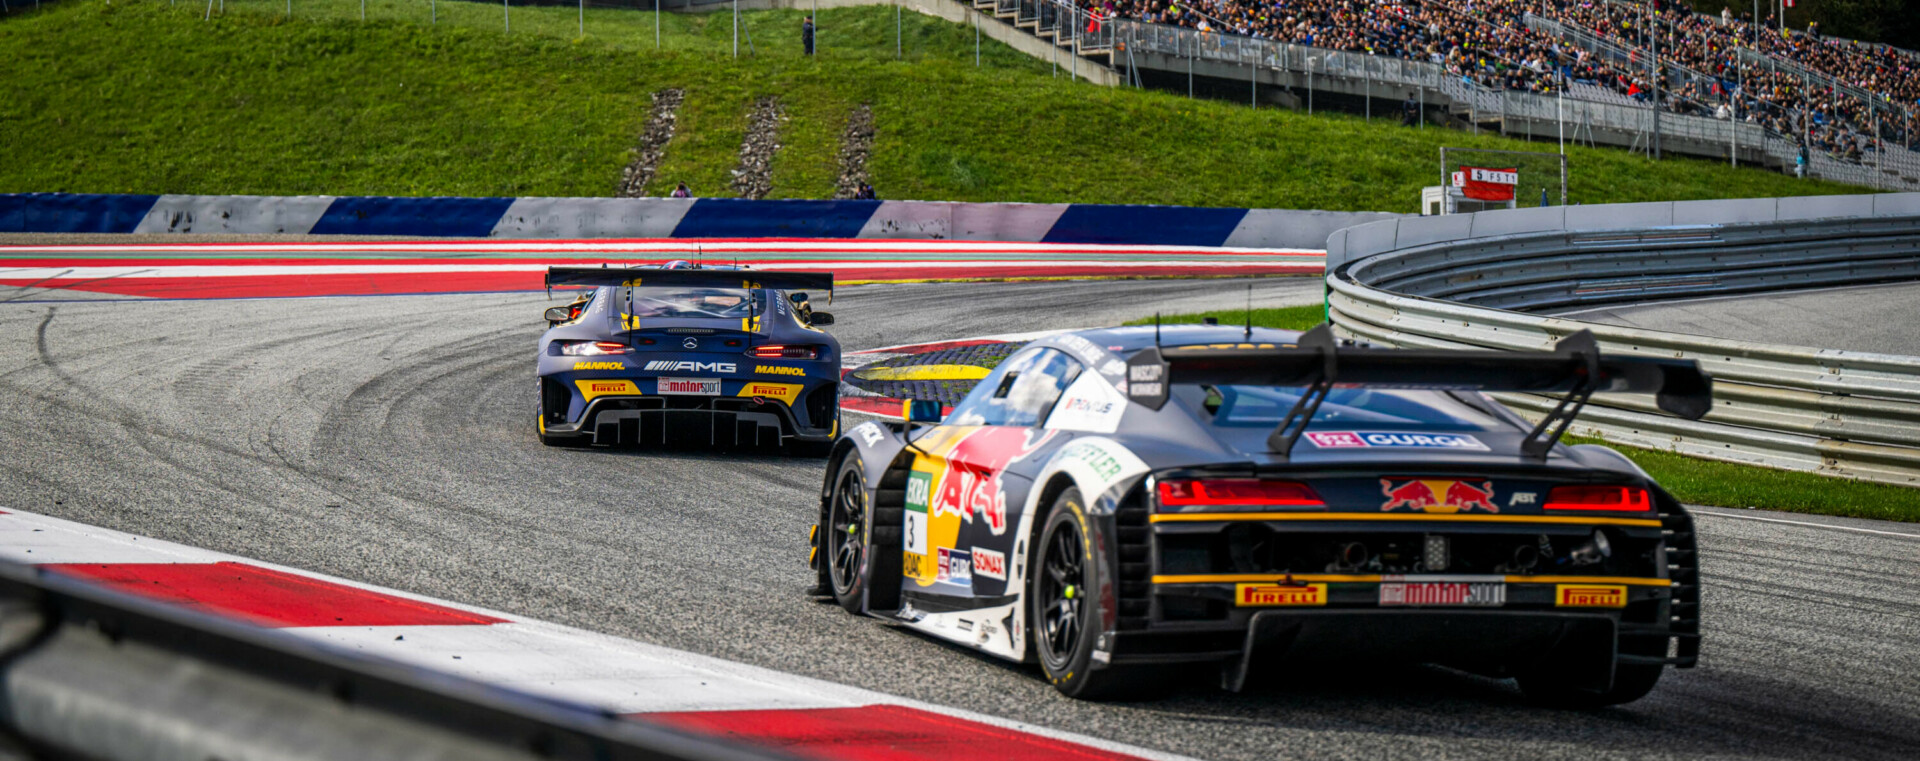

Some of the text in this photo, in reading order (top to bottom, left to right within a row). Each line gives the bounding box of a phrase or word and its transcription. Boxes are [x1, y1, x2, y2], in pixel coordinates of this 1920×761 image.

[1477, 170, 1482, 180] 5
[573, 361, 626, 371] MANNOL
[673, 361, 737, 374] AMG
[754, 365, 807, 377] MANNOL
[591, 383, 626, 393] PIRELLI
[752, 385, 788, 396] PIRELLI
[1367, 432, 1474, 448] GURGL
[909, 515, 915, 549] 3
[973, 551, 1003, 575] SONAX
[1244, 586, 1318, 603] PIRELLI
[1563, 588, 1621, 605] PIRELLI
